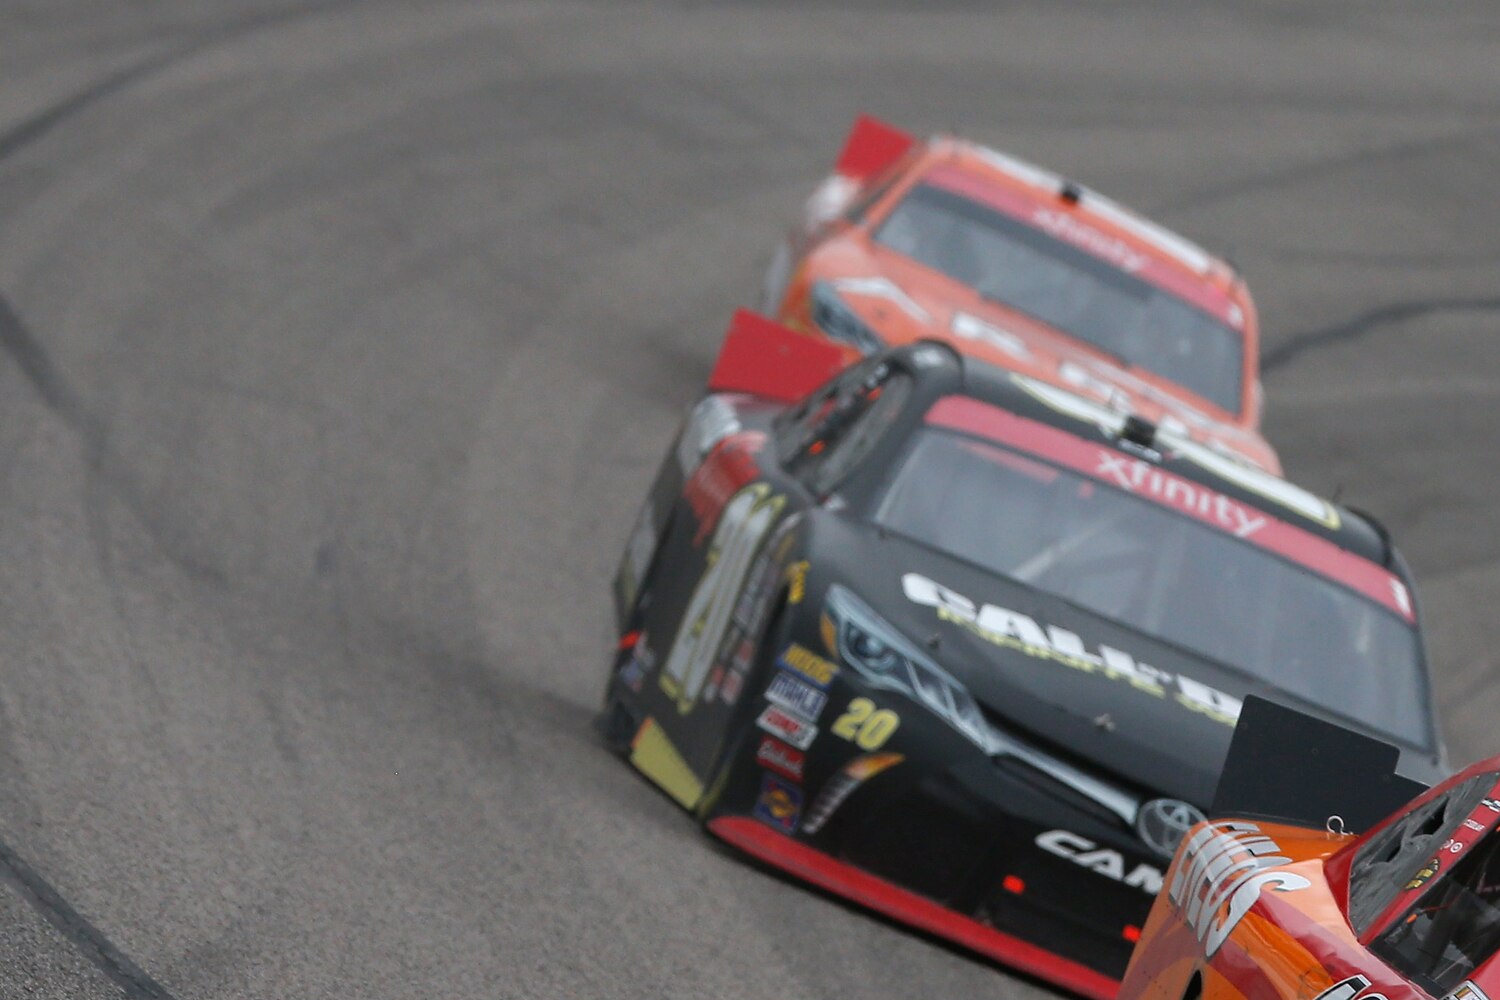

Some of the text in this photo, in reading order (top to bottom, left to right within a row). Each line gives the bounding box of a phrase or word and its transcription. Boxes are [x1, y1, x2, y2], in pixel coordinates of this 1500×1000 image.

[1096, 452, 1267, 538] xfinity
[831, 697, 900, 751] 20
[1035, 829, 1166, 895] CAM
